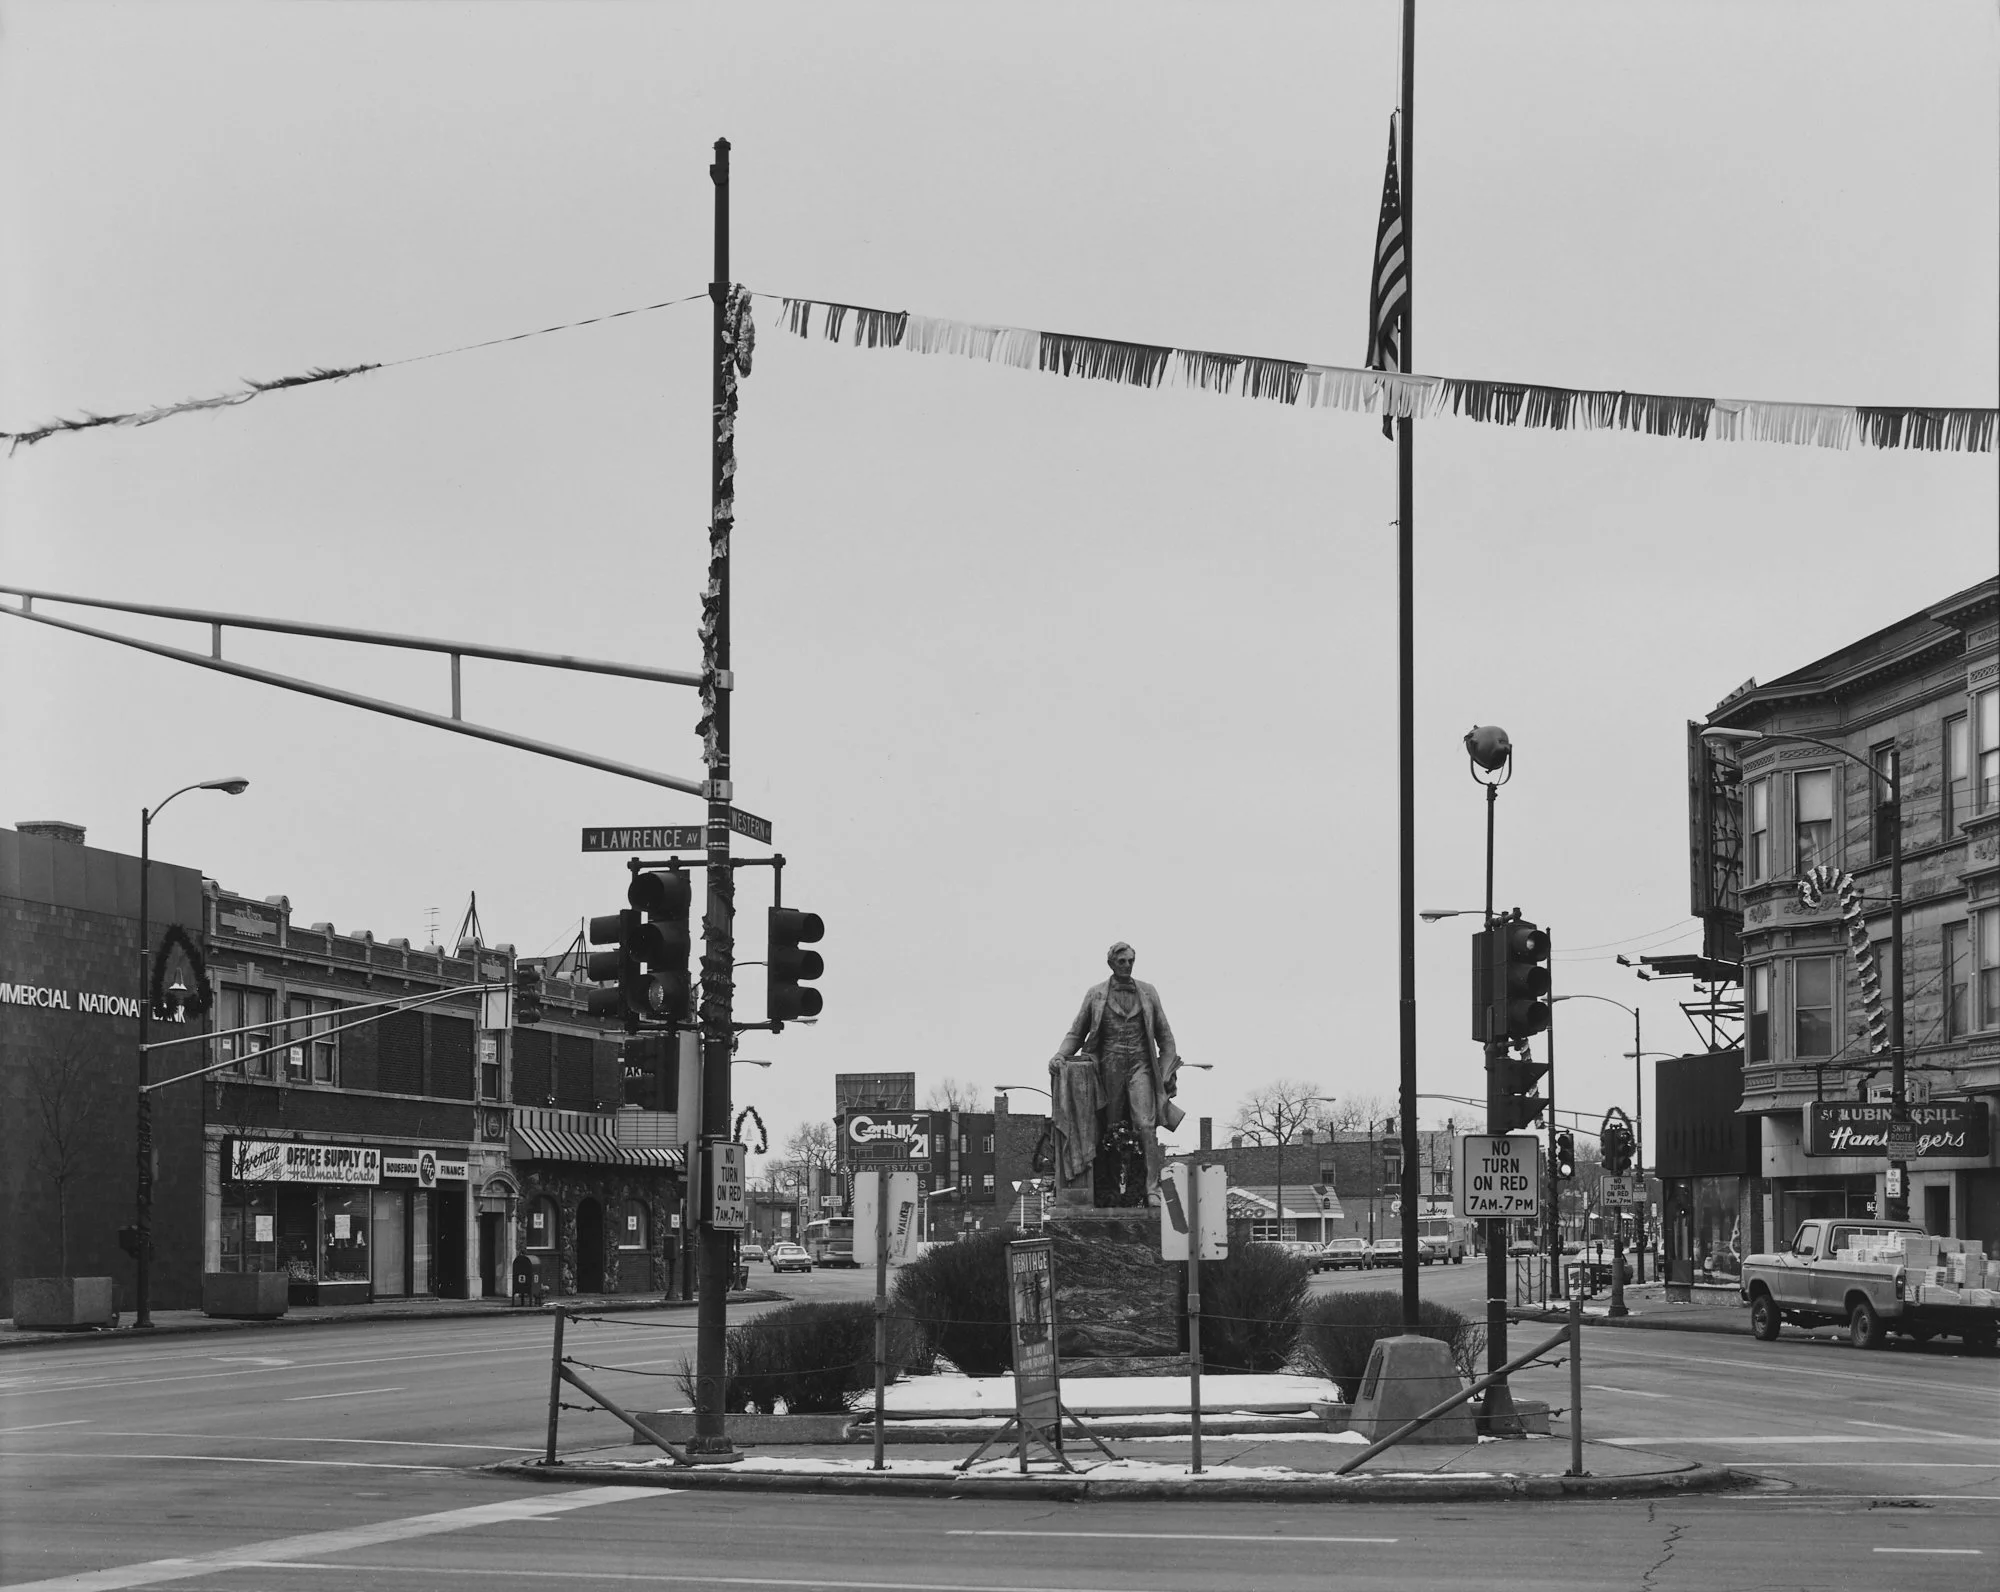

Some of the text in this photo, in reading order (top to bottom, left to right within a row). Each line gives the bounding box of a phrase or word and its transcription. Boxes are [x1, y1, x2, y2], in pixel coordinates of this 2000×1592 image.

[732, 810, 765, 839] WESTERN
[590, 830, 698, 848] W LAWRENCE AV
[79, 992, 140, 1017] NATIONA
[849, 1116, 918, 1143] Century
[1891, 1133, 1912, 1141] ROUTE
[909, 1134, 929, 1158] 21
[1492, 1140, 1510, 1156] NO
[287, 1147, 322, 1167] OFFICE
[324, 1149, 361, 1168] SUPPLY
[363, 1151, 379, 1169] CO.
[726, 1148, 735, 1164] NO
[287, 1165, 375, 1182] Hallmark Cards
[386, 1163, 417, 1174] HOUSEHOLD
[441, 1165, 465, 1176] FINANCE
[1482, 1158, 1520, 1173] TURN
[721, 1166, 738, 1183] TURN
[1474, 1175, 1528, 1191] ON RED
[717, 1185, 741, 1202] ON RED
[1469, 1195, 1533, 1210] 7AM-7PM
[1012, 1252, 1048, 1274] HERITAGE
